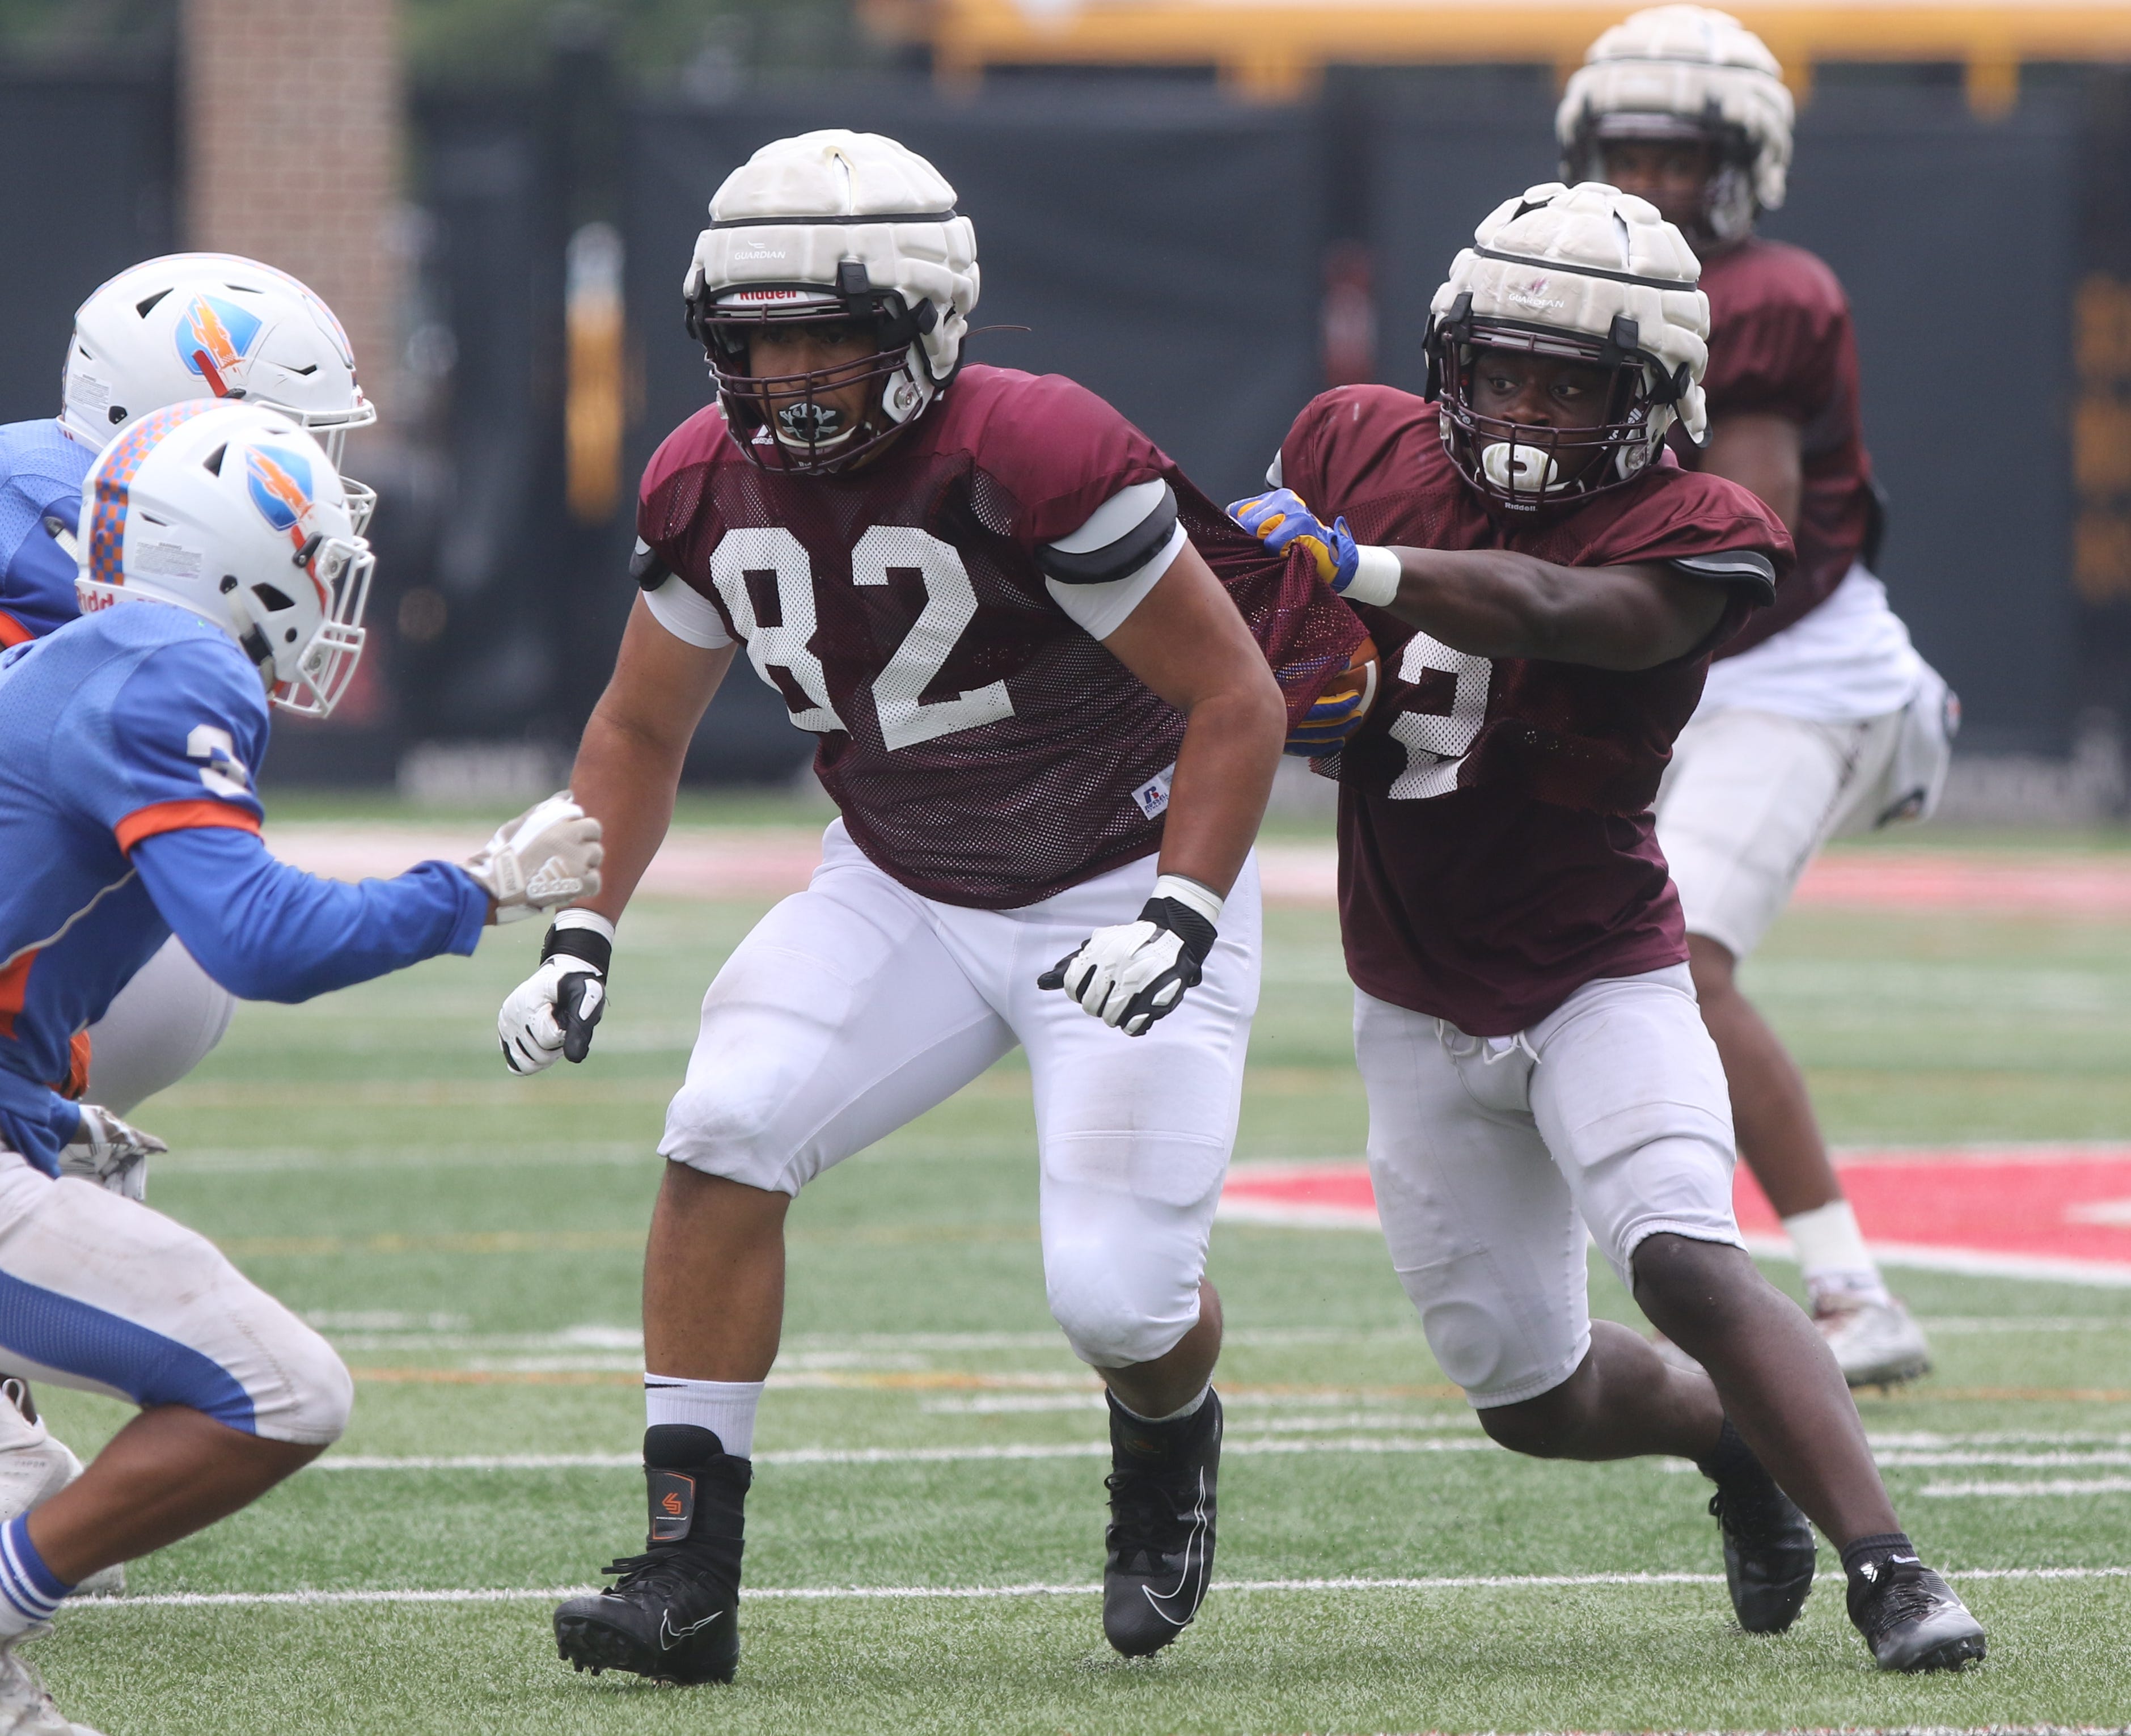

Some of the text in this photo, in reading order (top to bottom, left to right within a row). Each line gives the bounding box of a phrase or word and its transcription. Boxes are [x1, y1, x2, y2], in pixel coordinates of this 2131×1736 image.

[735, 251, 786, 260] GUARDIAN
[1508, 293, 1565, 308] GUARDIAN
[709, 525, 1016, 752] 82
